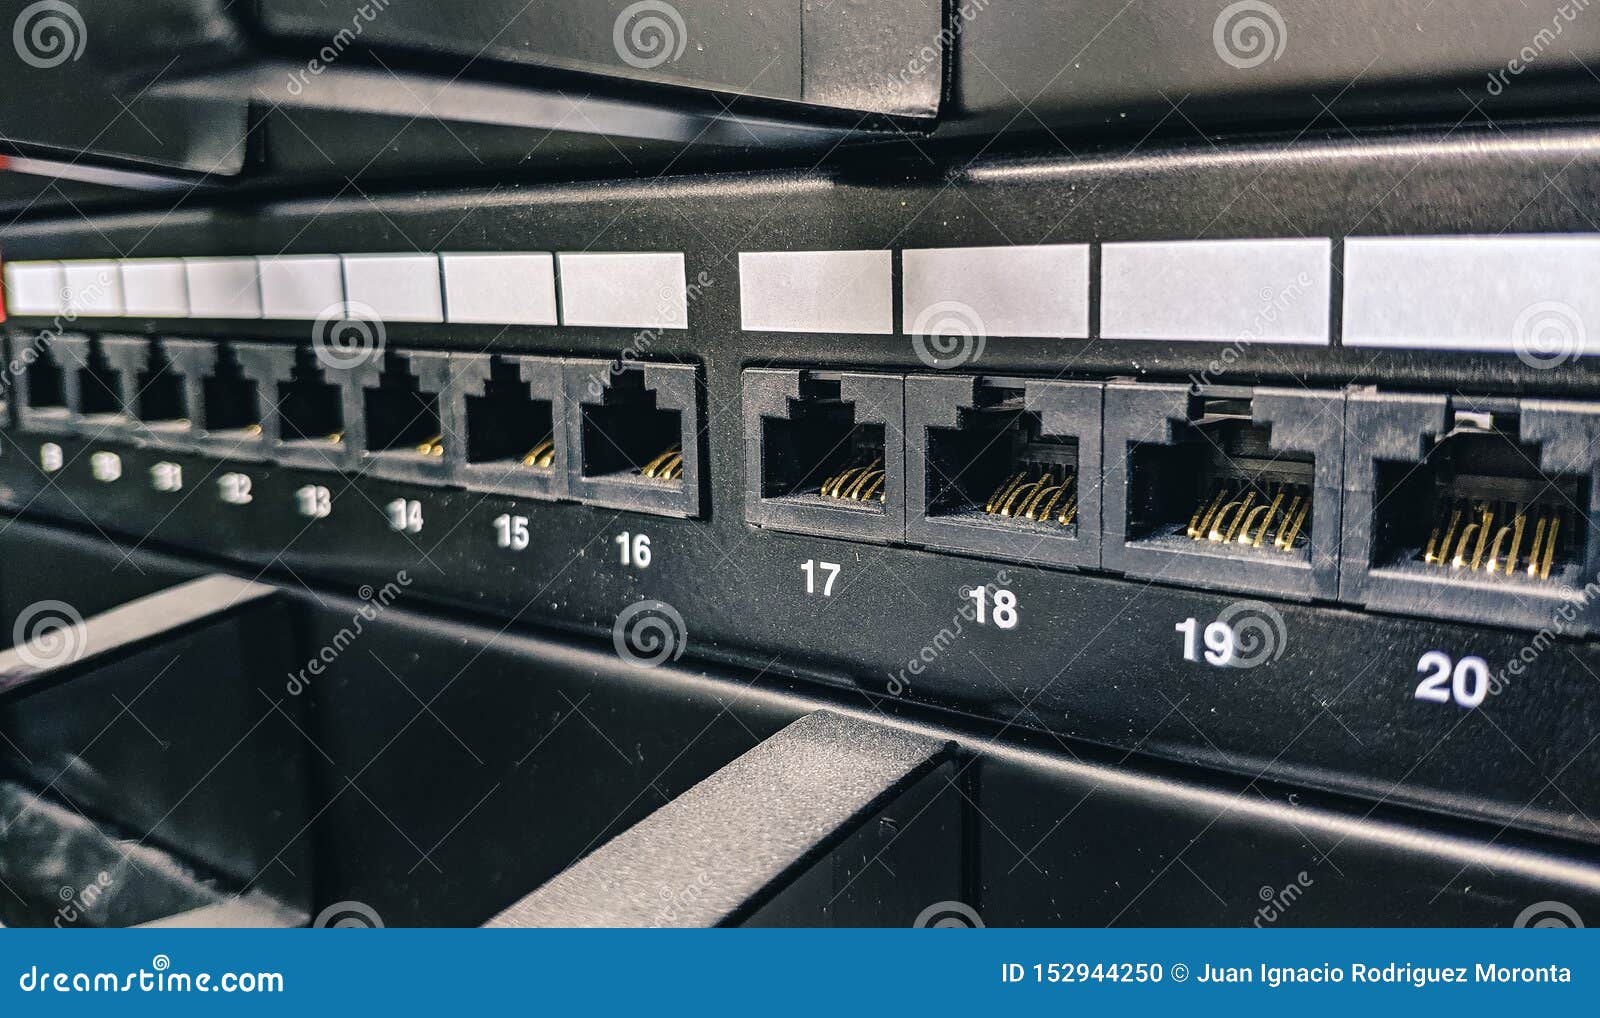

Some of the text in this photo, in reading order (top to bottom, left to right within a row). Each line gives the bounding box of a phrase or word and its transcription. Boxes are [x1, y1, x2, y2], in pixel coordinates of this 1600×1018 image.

[217, 472, 253, 504] 12
[296, 484, 332, 518] 13
[387, 498, 424, 534] 14
[494, 513, 530, 551] 15
[615, 531, 652, 569] 16
[800, 558, 842, 598] 17
[968, 585, 1018, 629] 18
[1174, 616, 1236, 668] 19
[1414, 652, 1490, 708] 20
